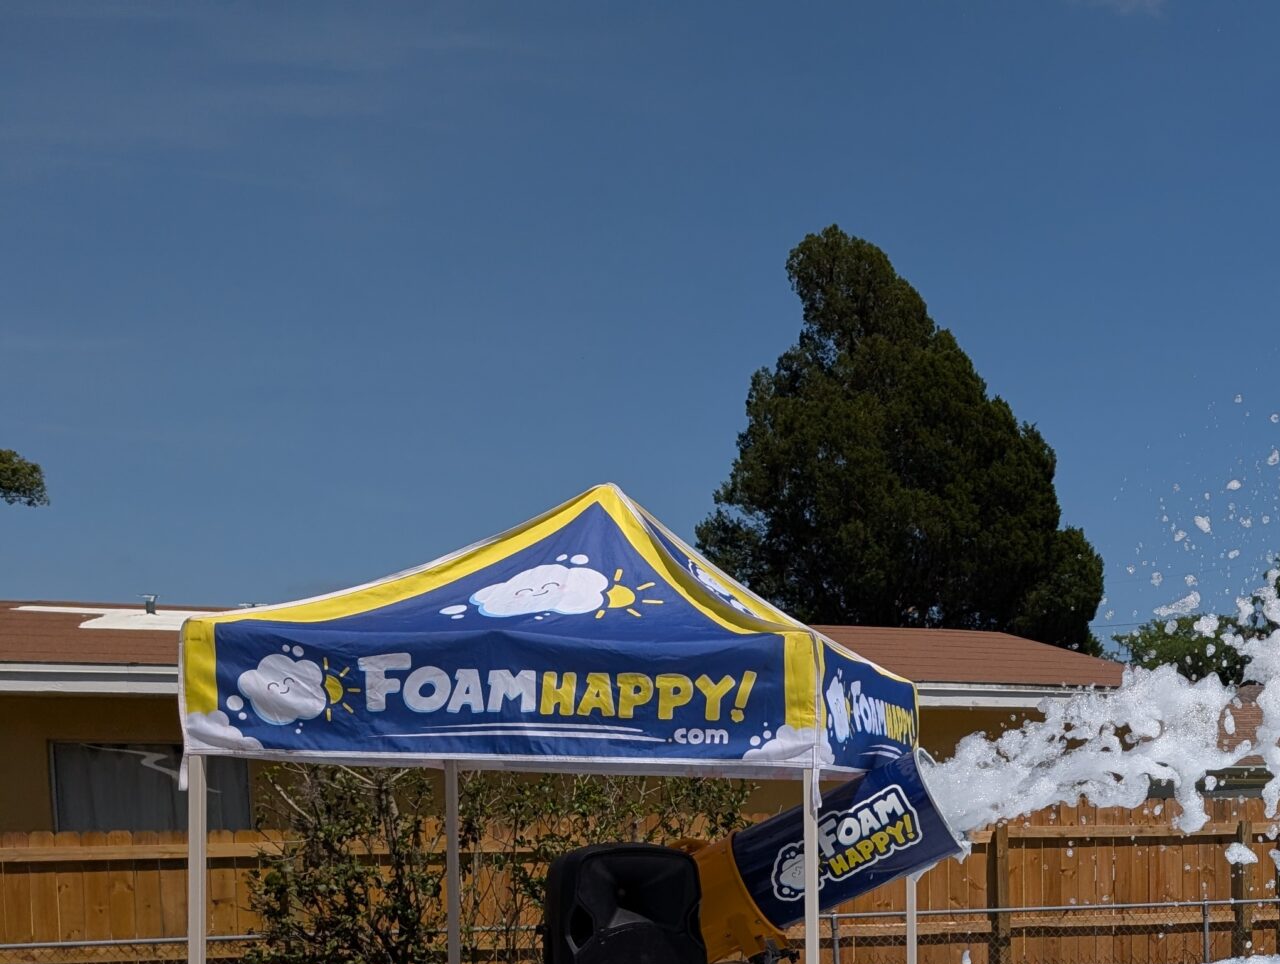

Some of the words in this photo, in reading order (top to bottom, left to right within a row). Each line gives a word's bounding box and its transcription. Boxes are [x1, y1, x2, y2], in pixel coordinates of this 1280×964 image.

[667, 727, 729, 745] .com
[818, 792, 905, 858] FOAM
[828, 814, 915, 876] HAPPY!
